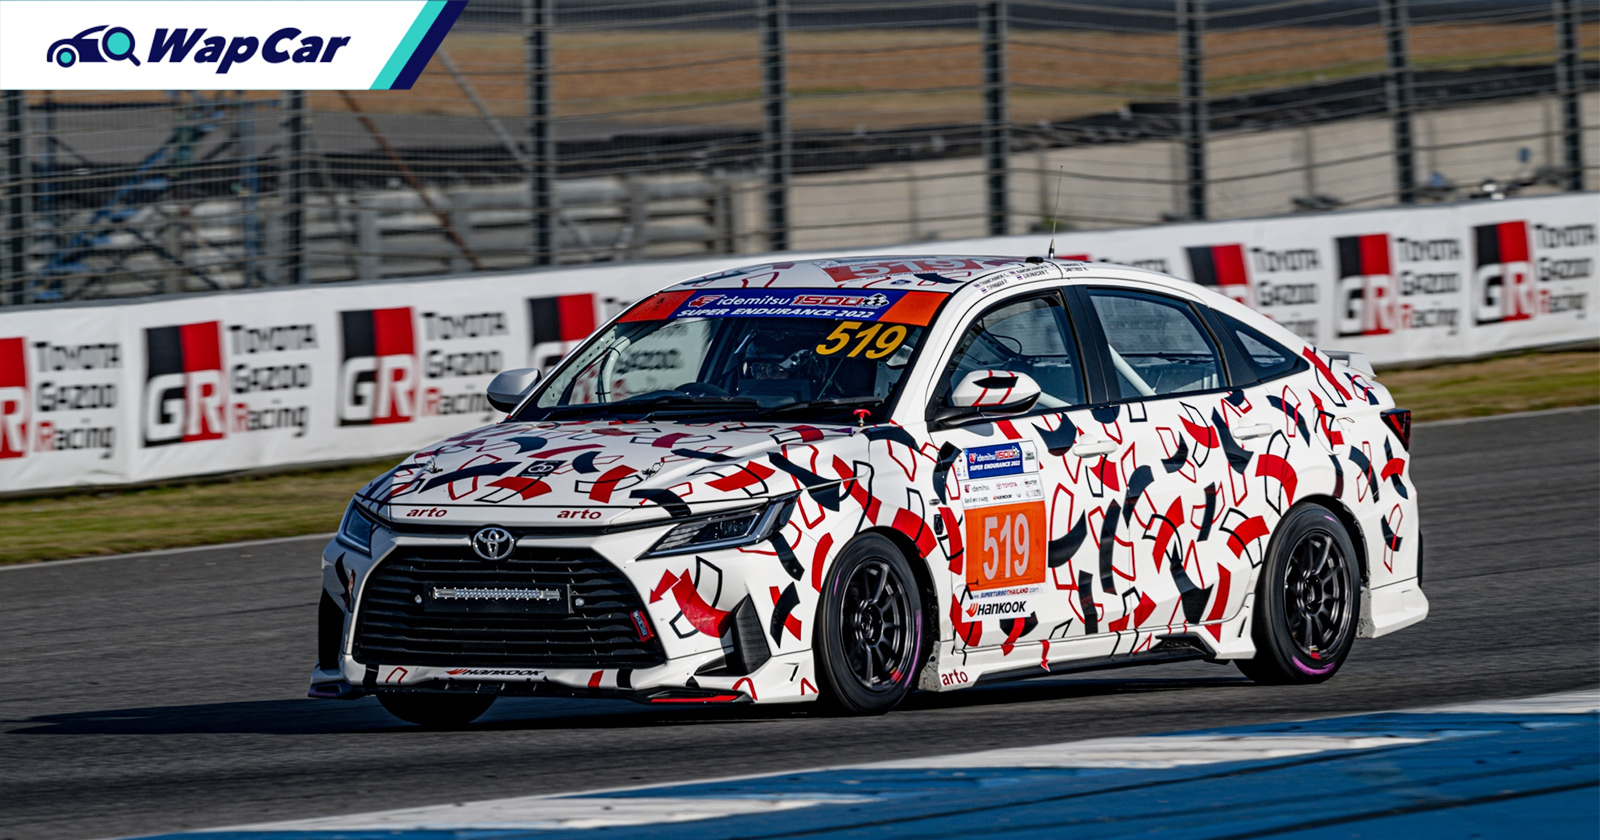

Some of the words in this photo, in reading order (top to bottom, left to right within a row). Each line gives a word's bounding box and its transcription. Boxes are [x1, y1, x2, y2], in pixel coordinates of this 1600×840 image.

[1394, 238, 1463, 262] TOYOTA
[717, 295, 790, 306] idemitsu
[792, 294, 866, 307] 1500
[1336, 274, 1397, 333] GR
[1475, 261, 1535, 320] GR
[422, 312, 510, 341] TOYOTA
[676, 308, 730, 317] SUPER
[730, 308, 838, 317] ENDURANCE
[835, 310, 875, 318] 2022
[227, 324, 318, 356] TOYOTA
[815, 321, 907, 359] 519
[32, 341, 122, 372] TOYOTA
[424, 350, 503, 379] GAZOO
[231, 363, 311, 394] GAZOO
[340, 354, 420, 420] GR
[36, 382, 117, 412] GAZOO
[145, 369, 228, 440] GR
[0, 386, 27, 453] R
[231, 400, 310, 438] Racing
[33, 419, 116, 459] Racing
[970, 463, 983, 471] SUPER
[984, 462, 1010, 470] ENDURANCE
[406, 507, 448, 518] arto
[557, 509, 602, 520] arto
[983, 513, 1030, 580] 519
[941, 669, 968, 686] arto
